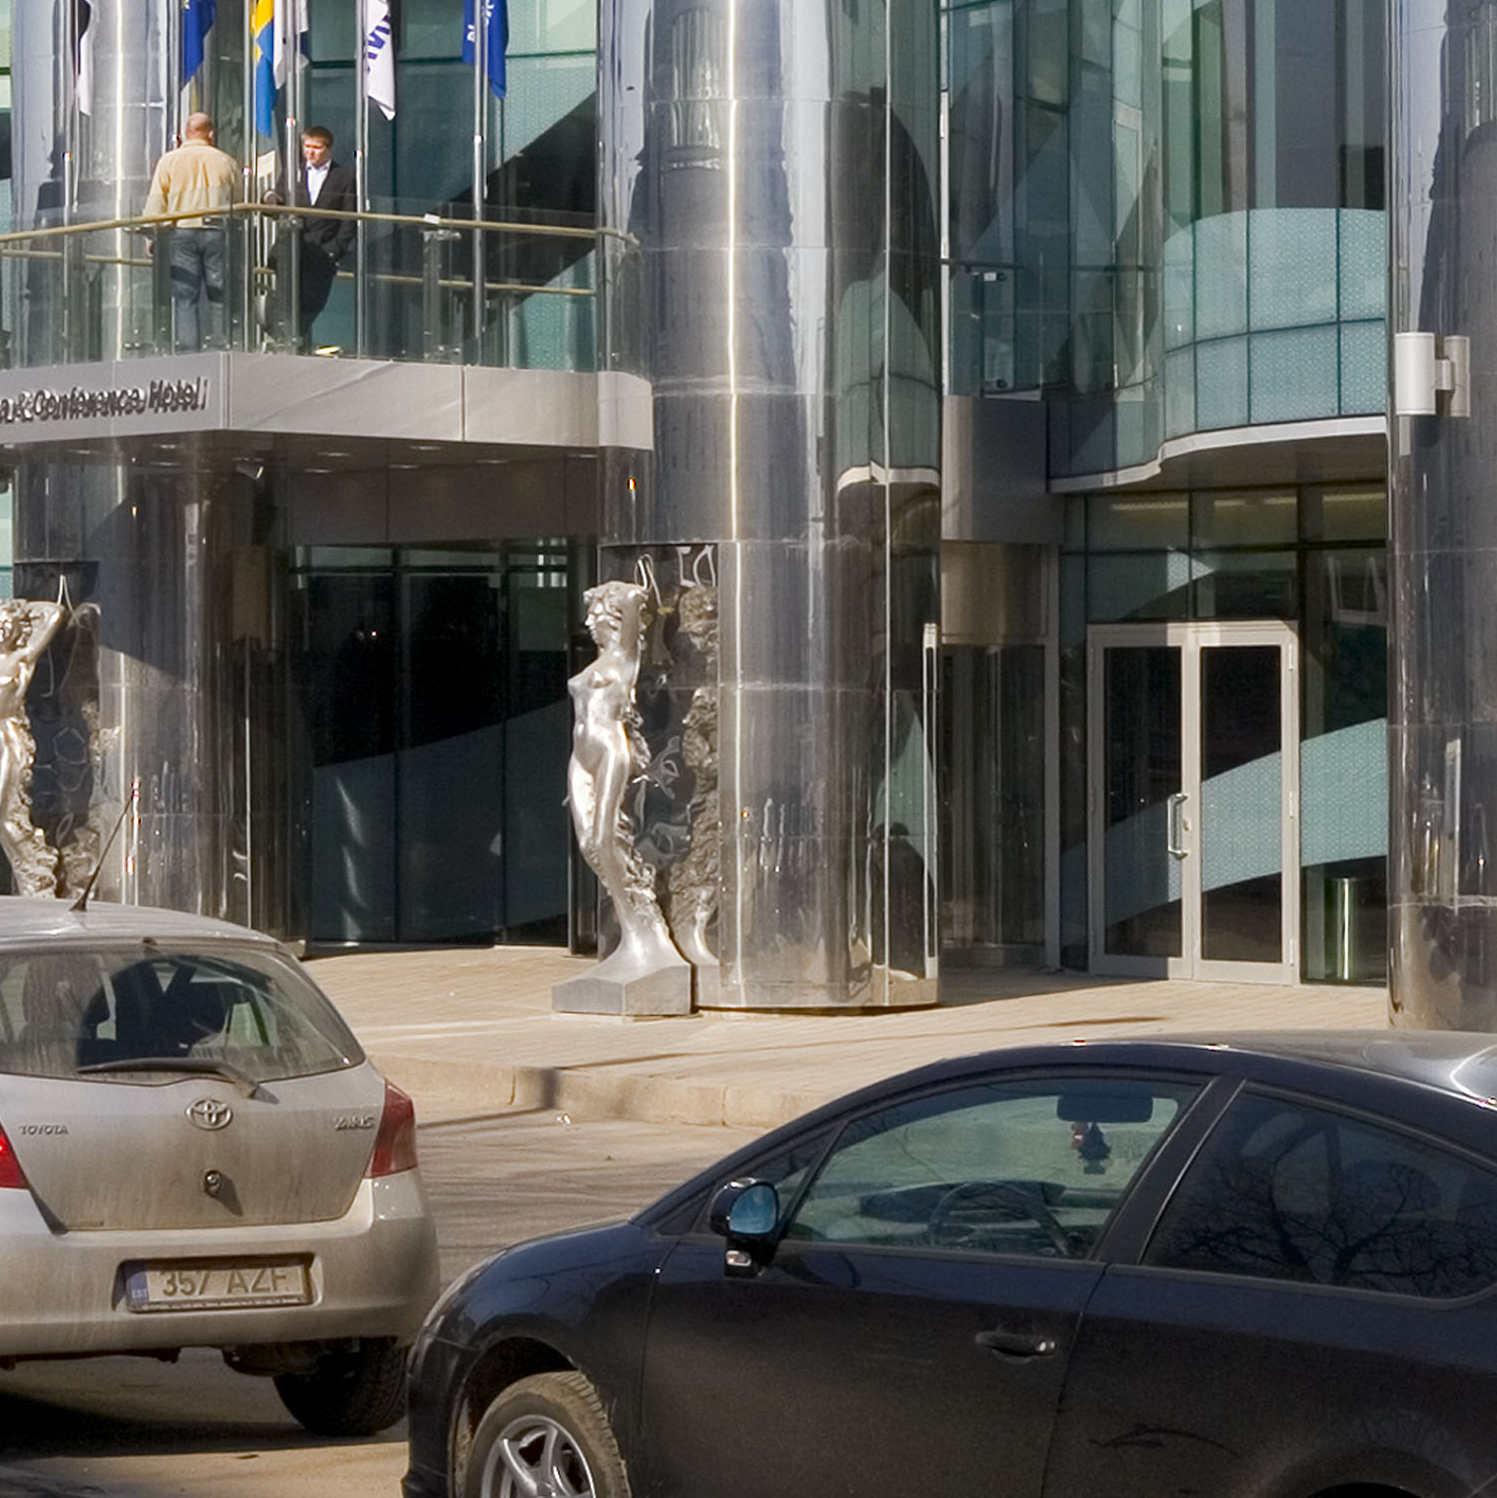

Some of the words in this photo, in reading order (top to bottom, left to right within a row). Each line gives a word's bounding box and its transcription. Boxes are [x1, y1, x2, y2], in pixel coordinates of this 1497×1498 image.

[33, 387, 147, 421] Conference
[149, 376, 208, 413] Hotel
[18, 1124, 70, 1136] TOYOTA
[159, 1270, 212, 1297] 357
